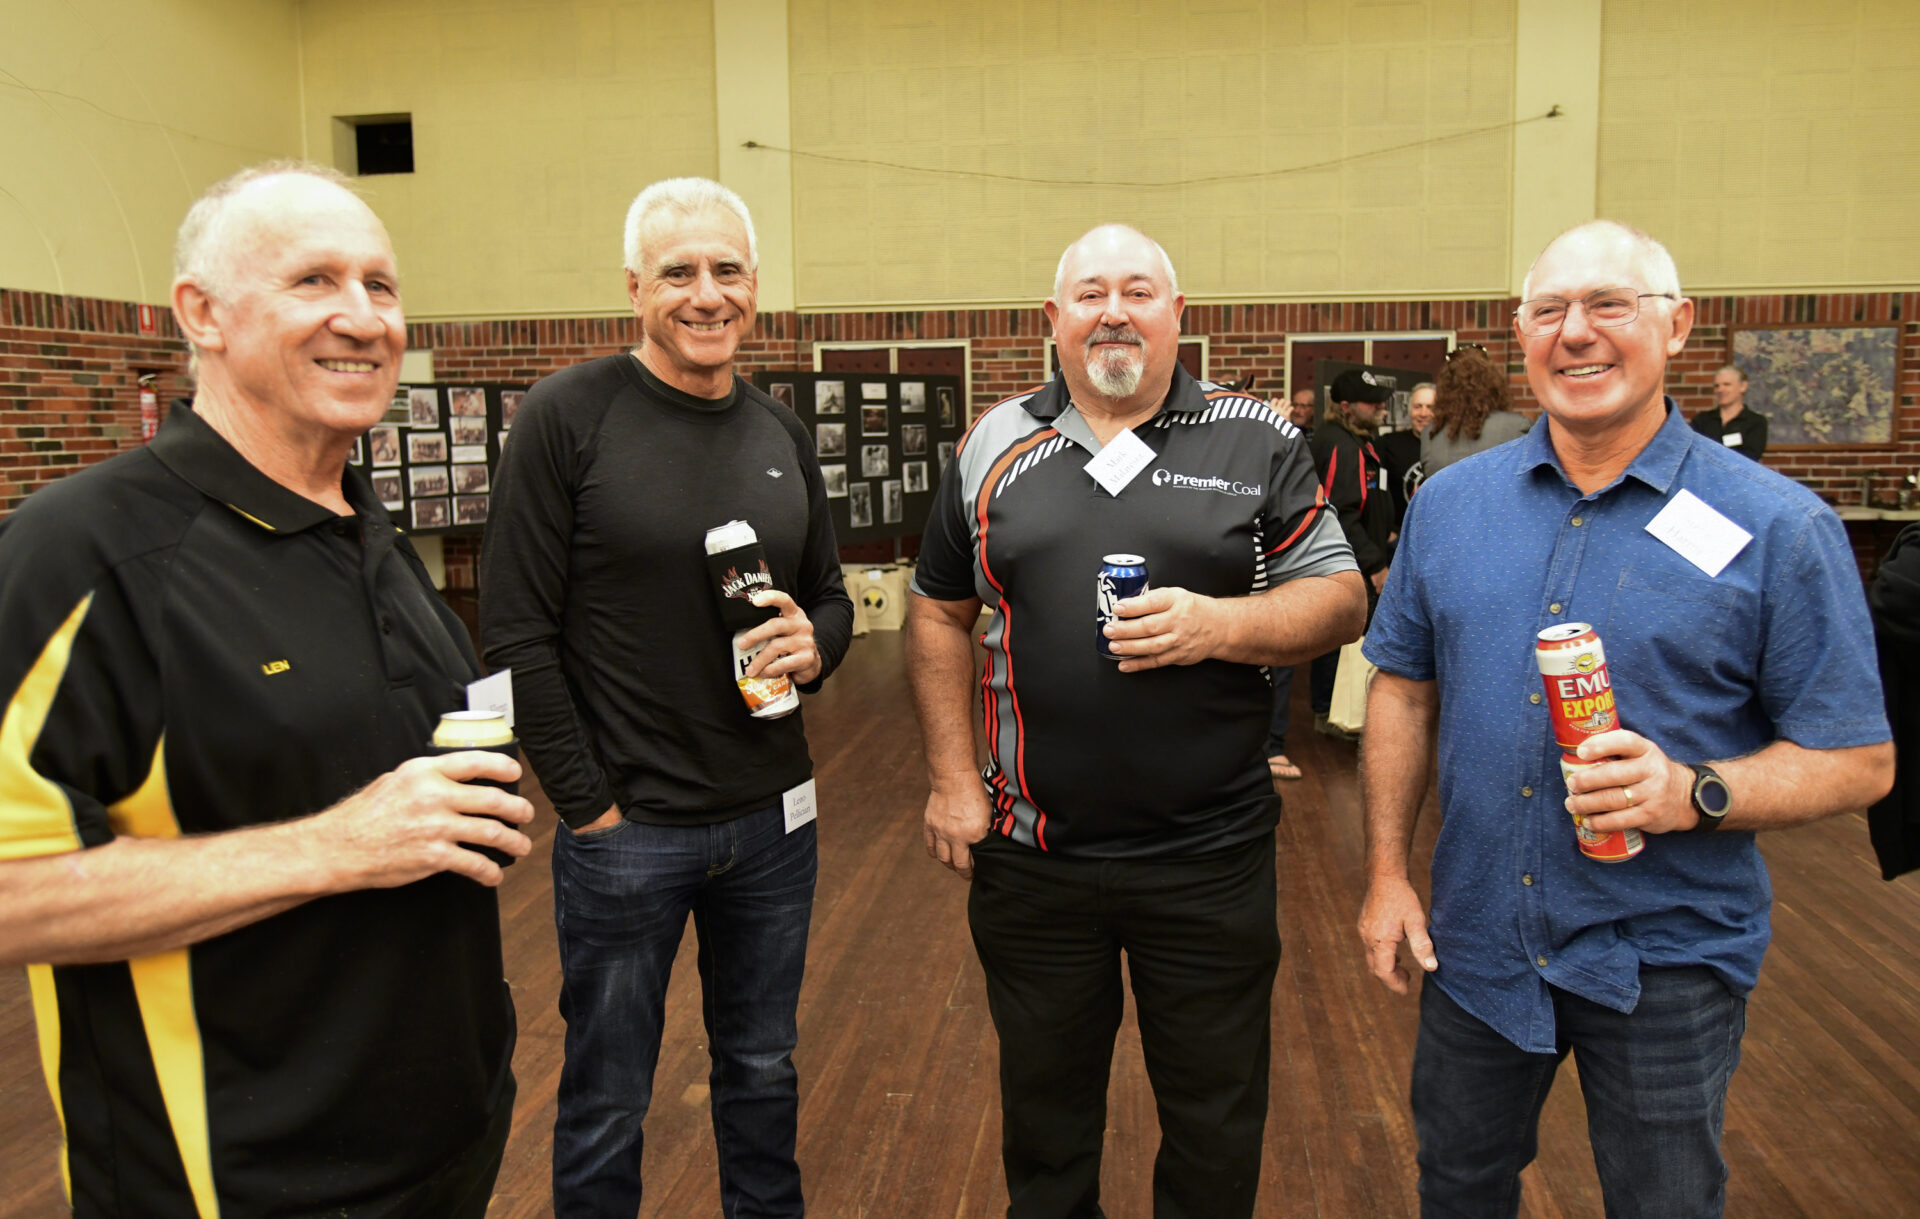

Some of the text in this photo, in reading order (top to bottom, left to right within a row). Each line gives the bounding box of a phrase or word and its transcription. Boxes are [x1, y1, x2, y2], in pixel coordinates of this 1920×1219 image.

[1173, 473, 1231, 491] Premier
[1232, 481, 1261, 496] Coal
[722, 577, 747, 598] JACK
[1556, 665, 1610, 699] EMU
